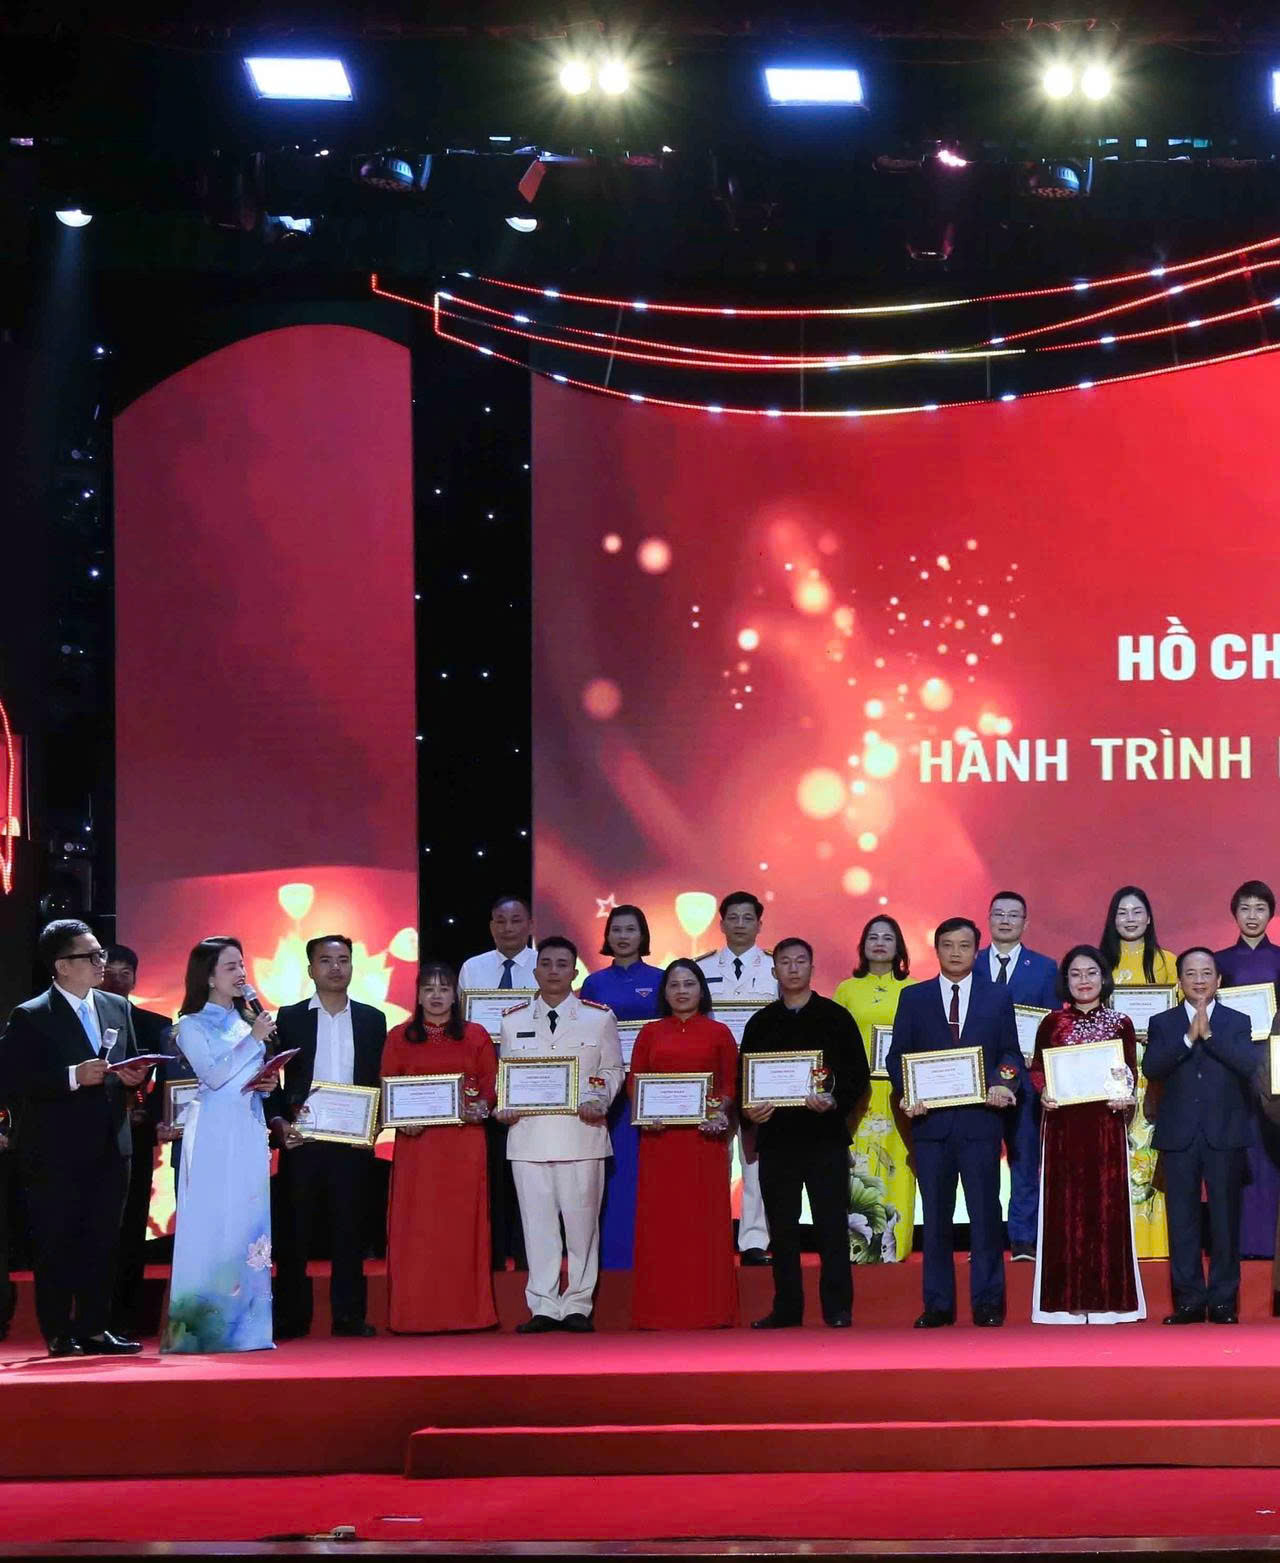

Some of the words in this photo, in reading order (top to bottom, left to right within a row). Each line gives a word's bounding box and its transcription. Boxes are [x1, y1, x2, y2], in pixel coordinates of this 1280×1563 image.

[1118, 616, 1196, 681] HỒ
[919, 731, 1068, 783] HÀNH
[1091, 728, 1251, 781] TRÌNH
